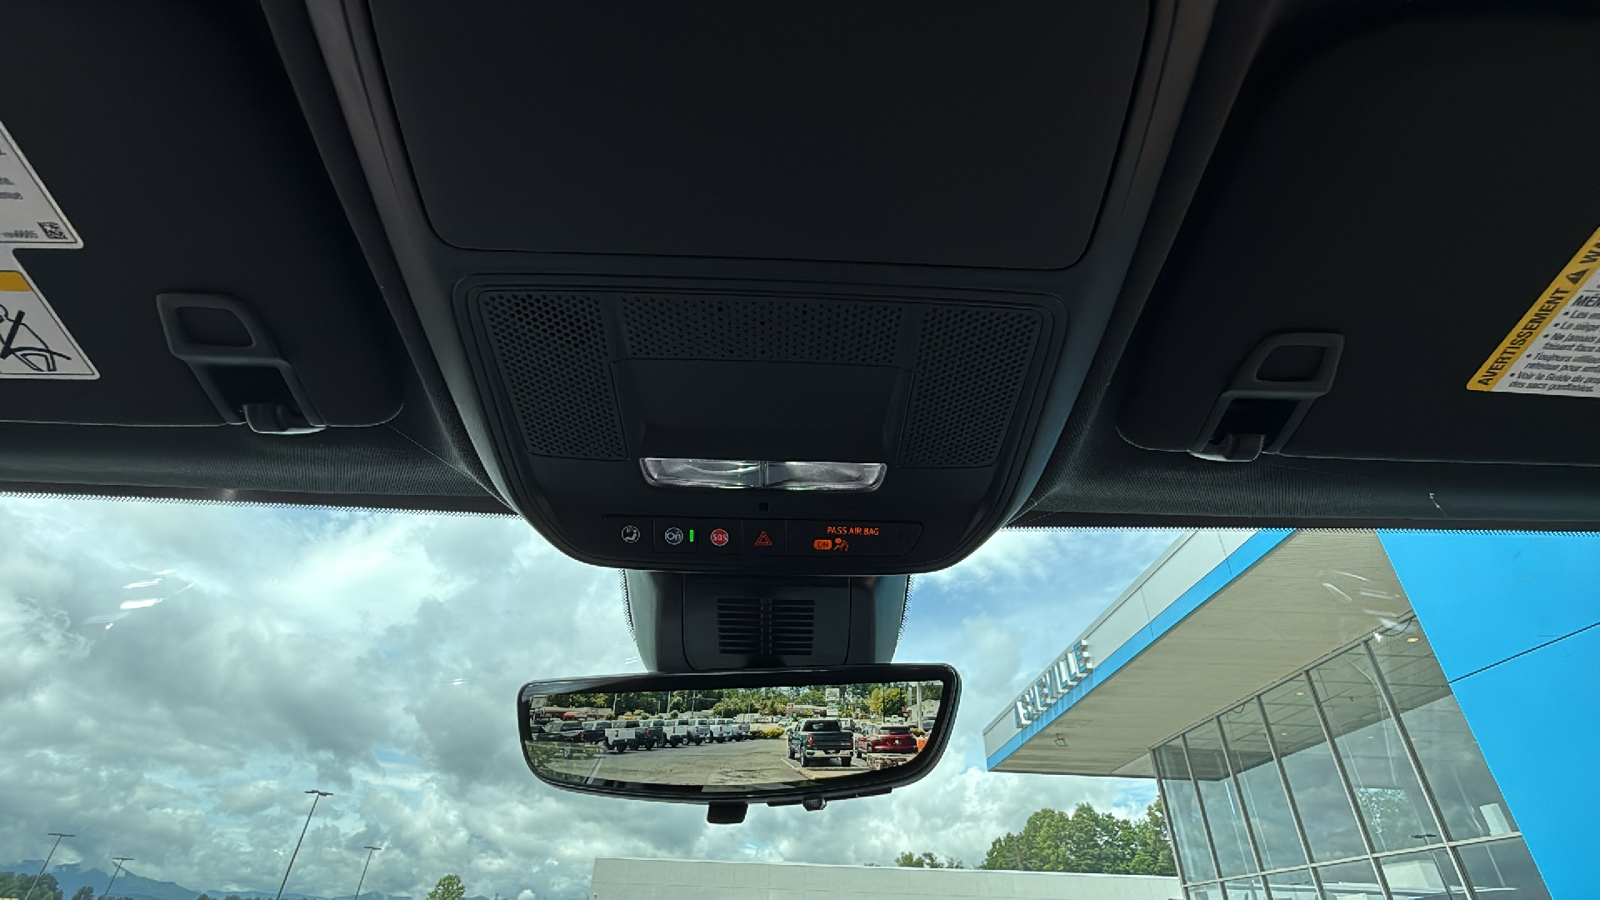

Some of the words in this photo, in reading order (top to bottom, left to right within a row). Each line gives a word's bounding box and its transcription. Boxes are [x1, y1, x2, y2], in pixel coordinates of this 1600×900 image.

[1478, 288, 1569, 386] AVERTISSEMENT
[827, 526, 847, 535] PASS
[848, 527, 862, 535] AIR
[863, 527, 879, 536] BAG
[712, 533, 728, 541] SOS
